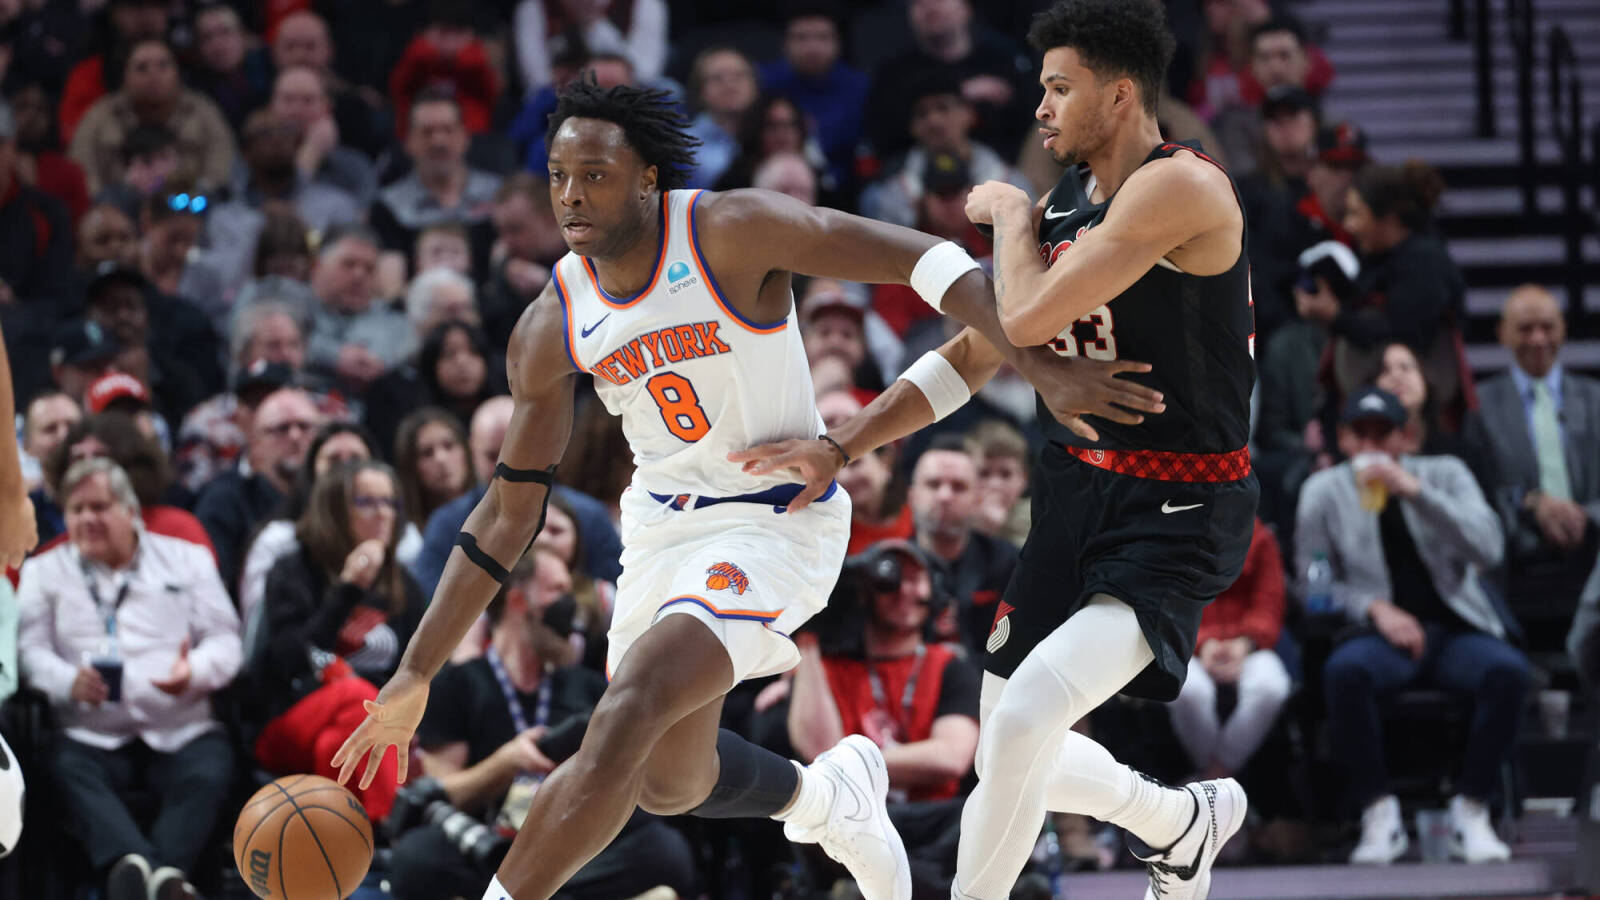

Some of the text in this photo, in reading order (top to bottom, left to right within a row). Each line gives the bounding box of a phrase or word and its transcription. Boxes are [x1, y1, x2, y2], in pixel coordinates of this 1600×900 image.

[668, 276, 697, 295] sphere
[589, 320, 732, 386] NEW YORK
[645, 371, 712, 443] 8
